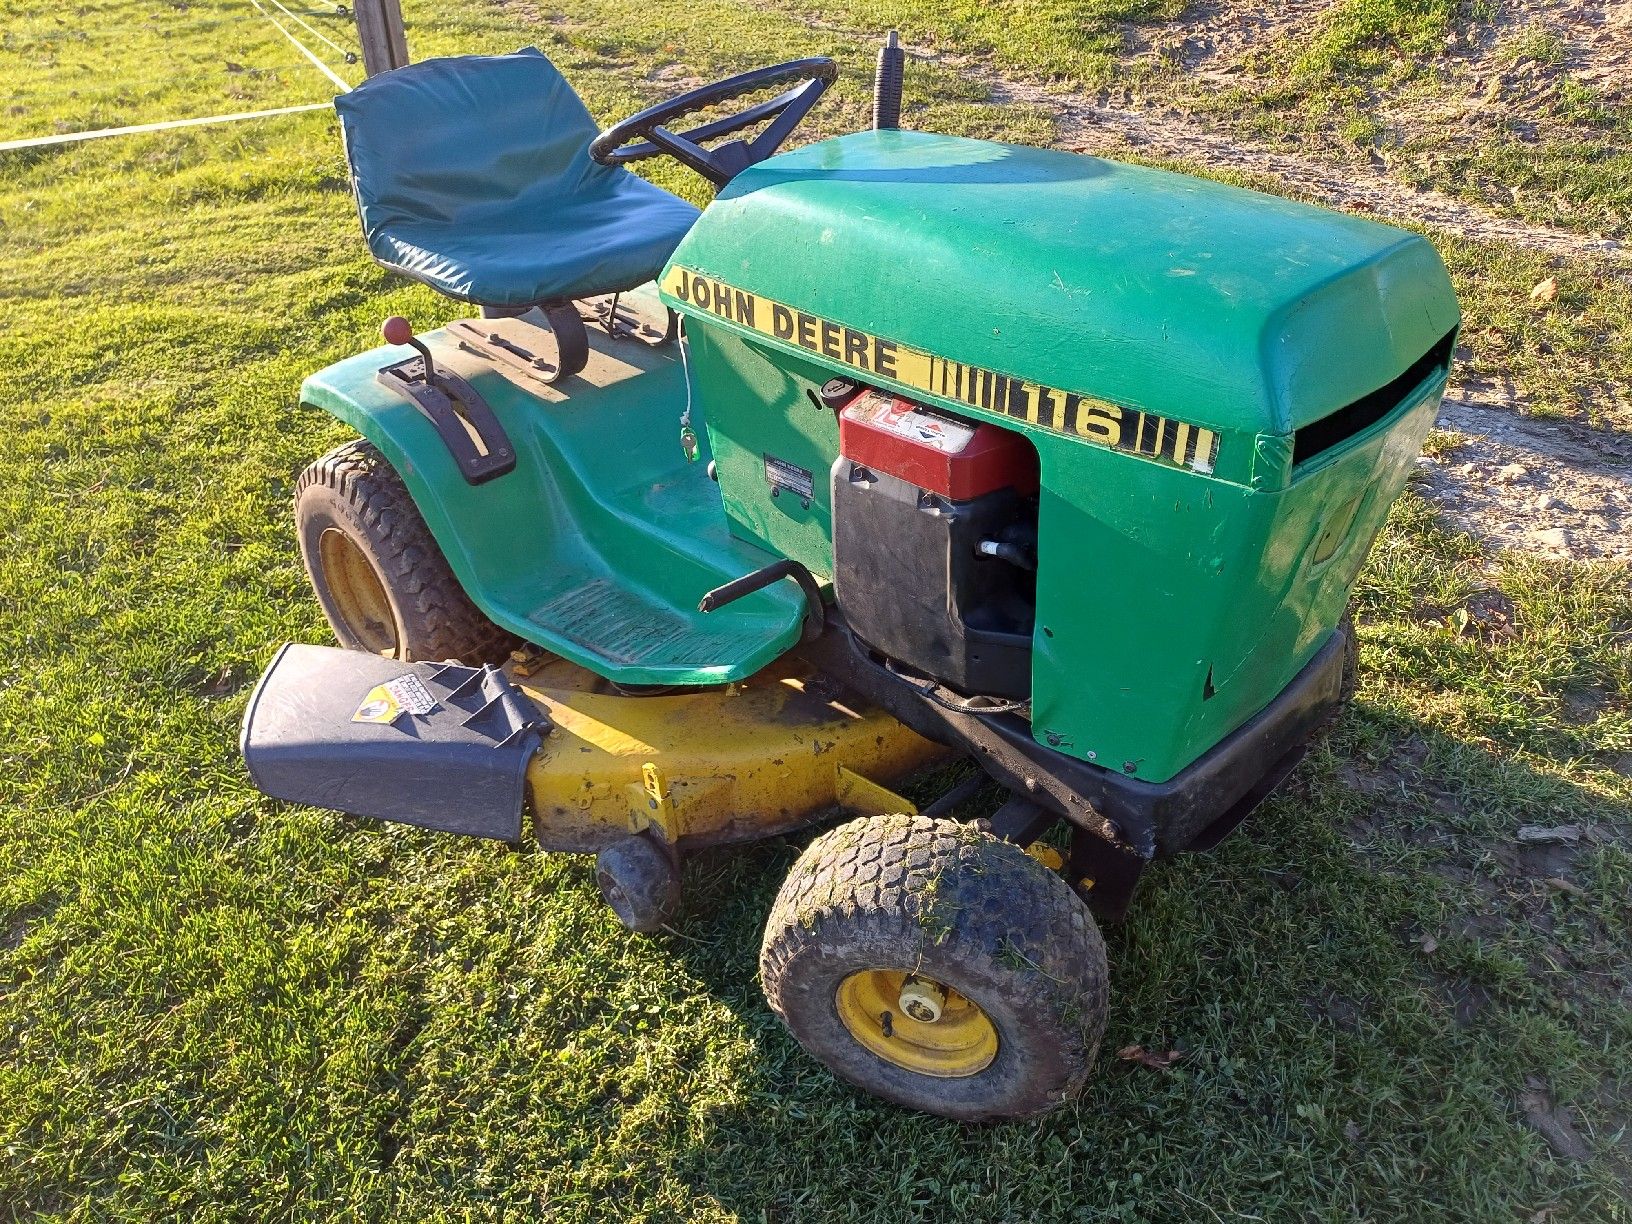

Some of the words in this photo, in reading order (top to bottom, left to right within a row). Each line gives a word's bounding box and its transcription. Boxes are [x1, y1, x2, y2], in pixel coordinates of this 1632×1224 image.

[676, 271, 755, 328] JOHN
[773, 303, 897, 379] DEERE
[1021, 382, 1122, 445] 116
